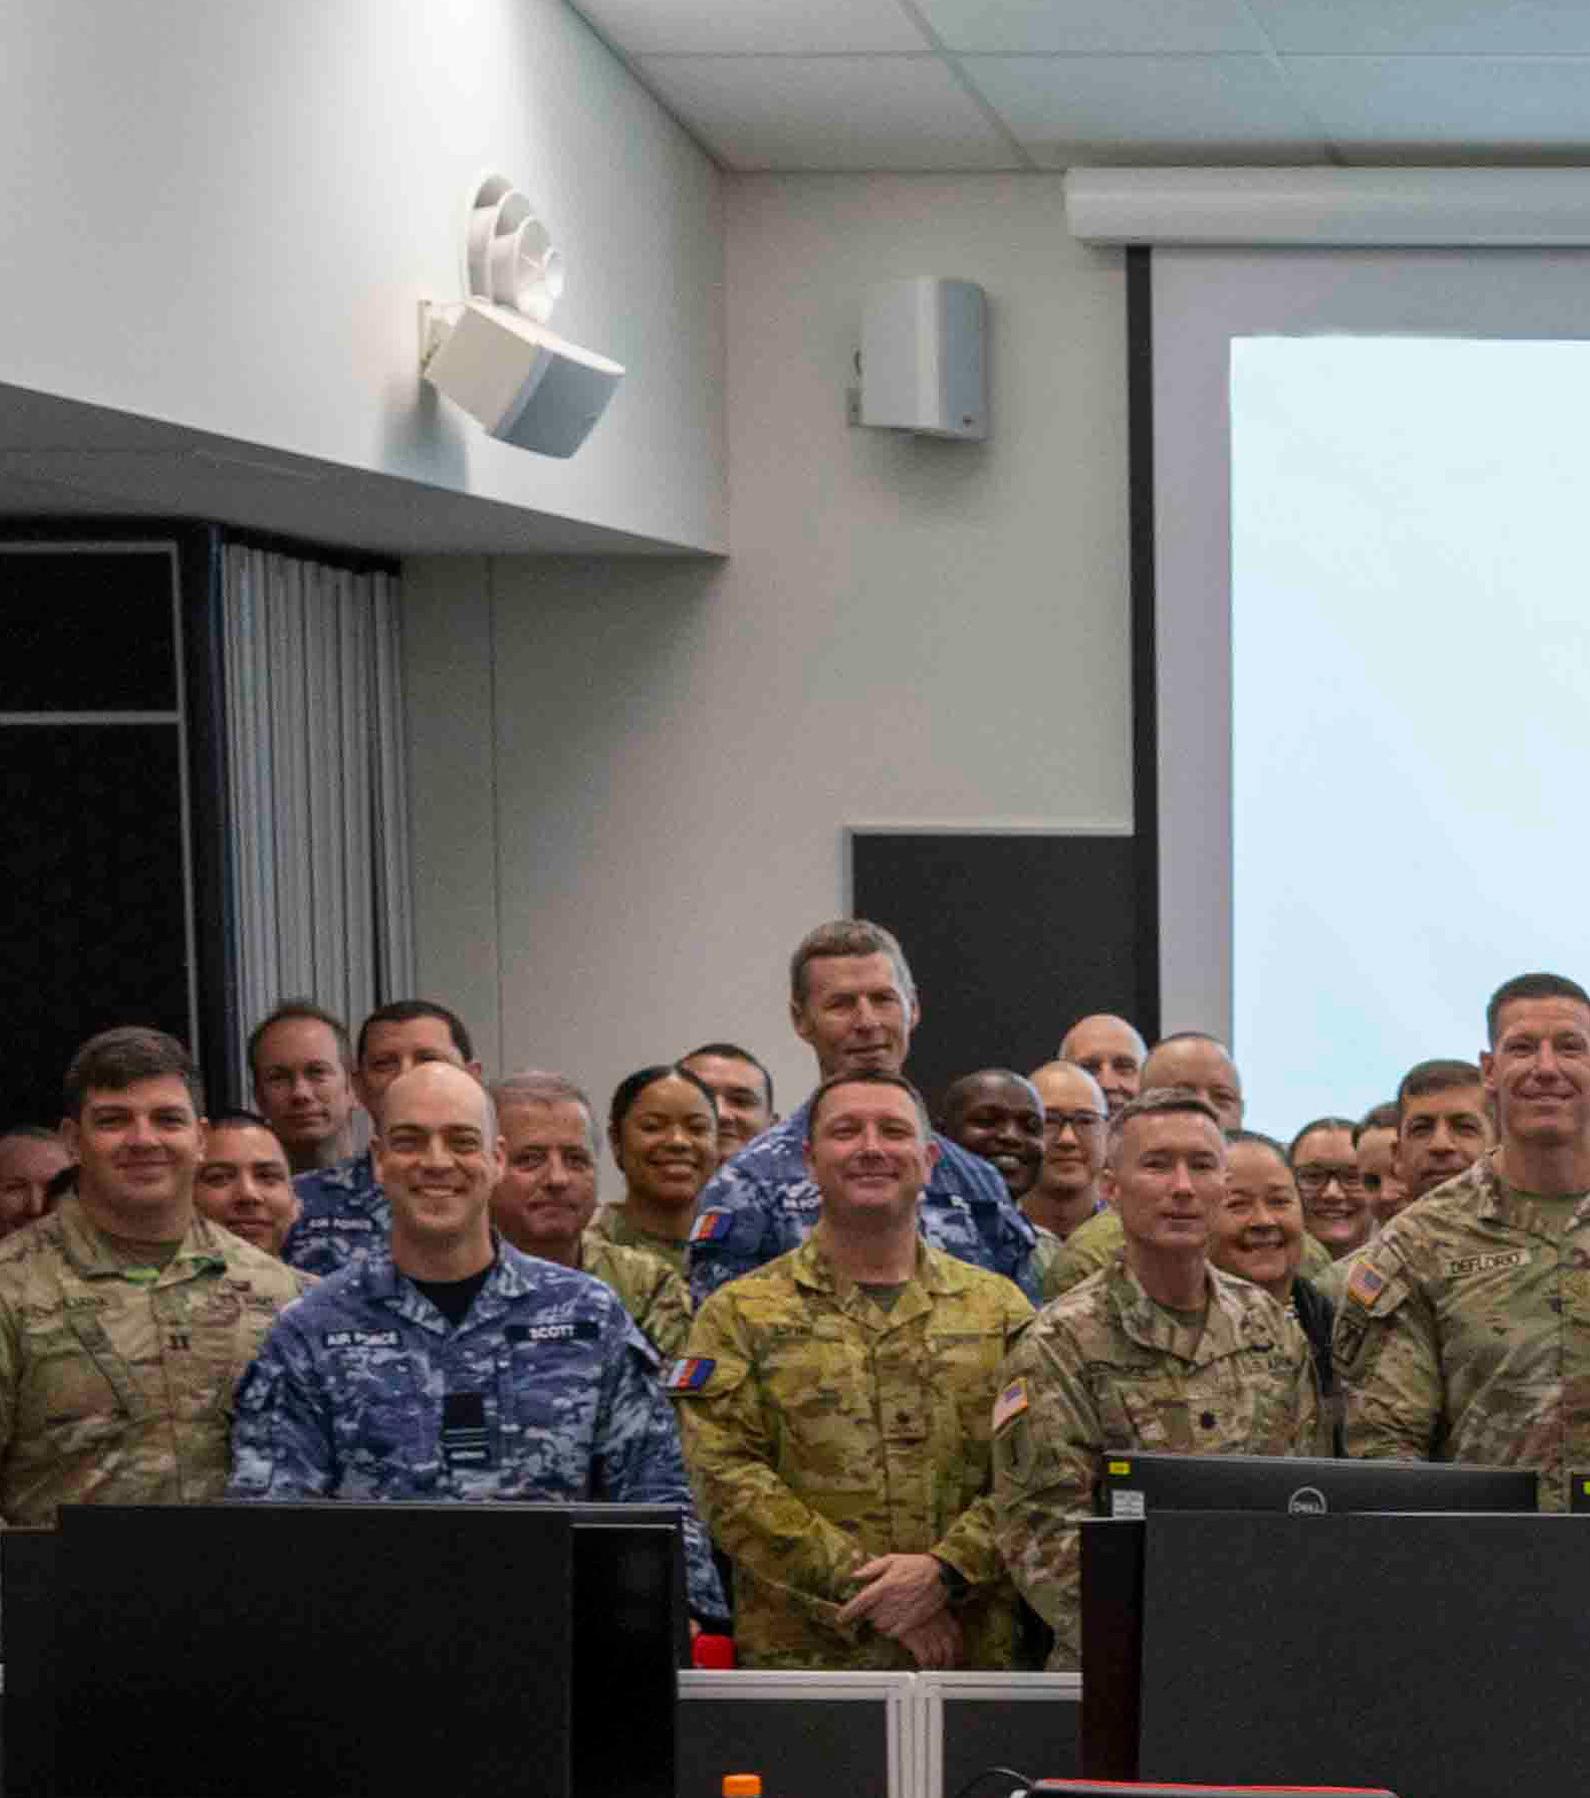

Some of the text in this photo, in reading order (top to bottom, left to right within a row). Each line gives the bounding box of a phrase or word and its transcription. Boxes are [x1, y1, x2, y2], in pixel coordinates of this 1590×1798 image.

[327, 1330, 399, 1346] AIR FORCE
[528, 1325, 575, 1341] SCOTT
